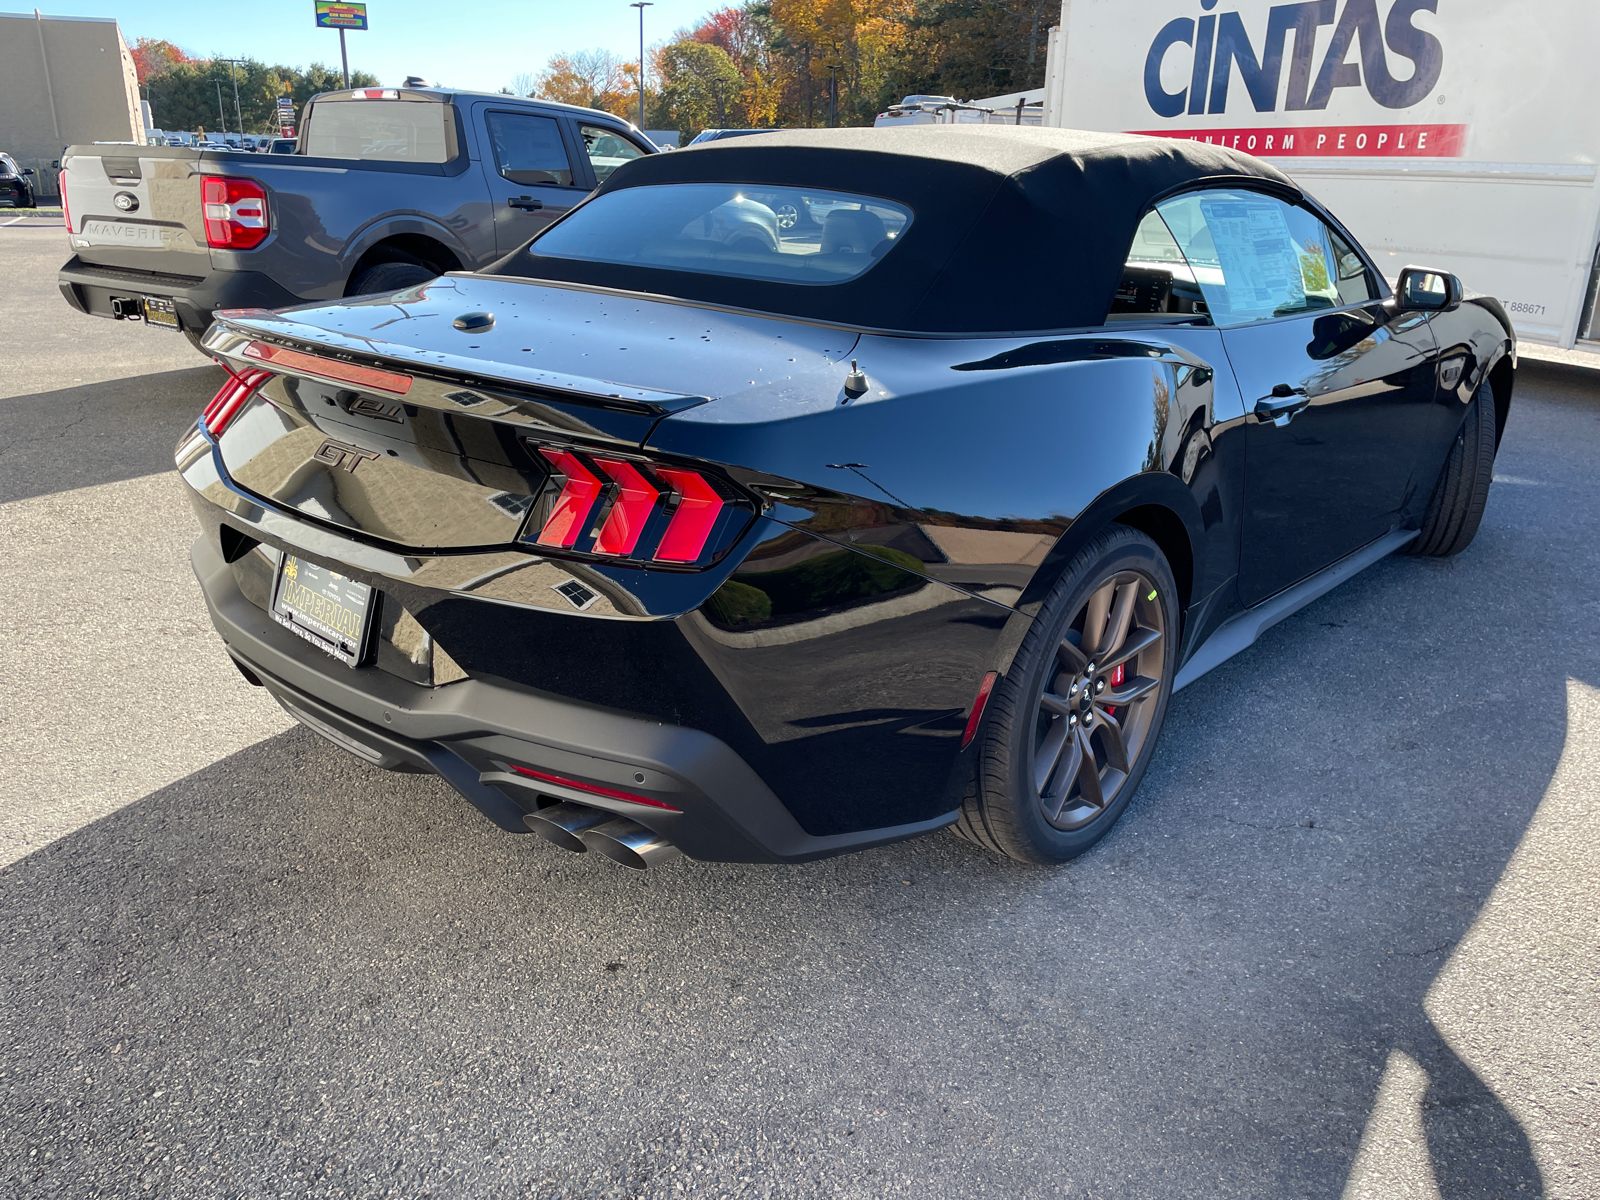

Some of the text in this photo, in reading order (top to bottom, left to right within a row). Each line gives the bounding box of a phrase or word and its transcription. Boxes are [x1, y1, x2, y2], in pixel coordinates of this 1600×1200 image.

[1316, 132, 1428, 149] PEOPLE
[88, 222, 187, 244] MAVERICK
[1510, 301, 1546, 315] 888671
[313, 437, 381, 474] GT
[282, 578, 361, 641] IMPERIAL
